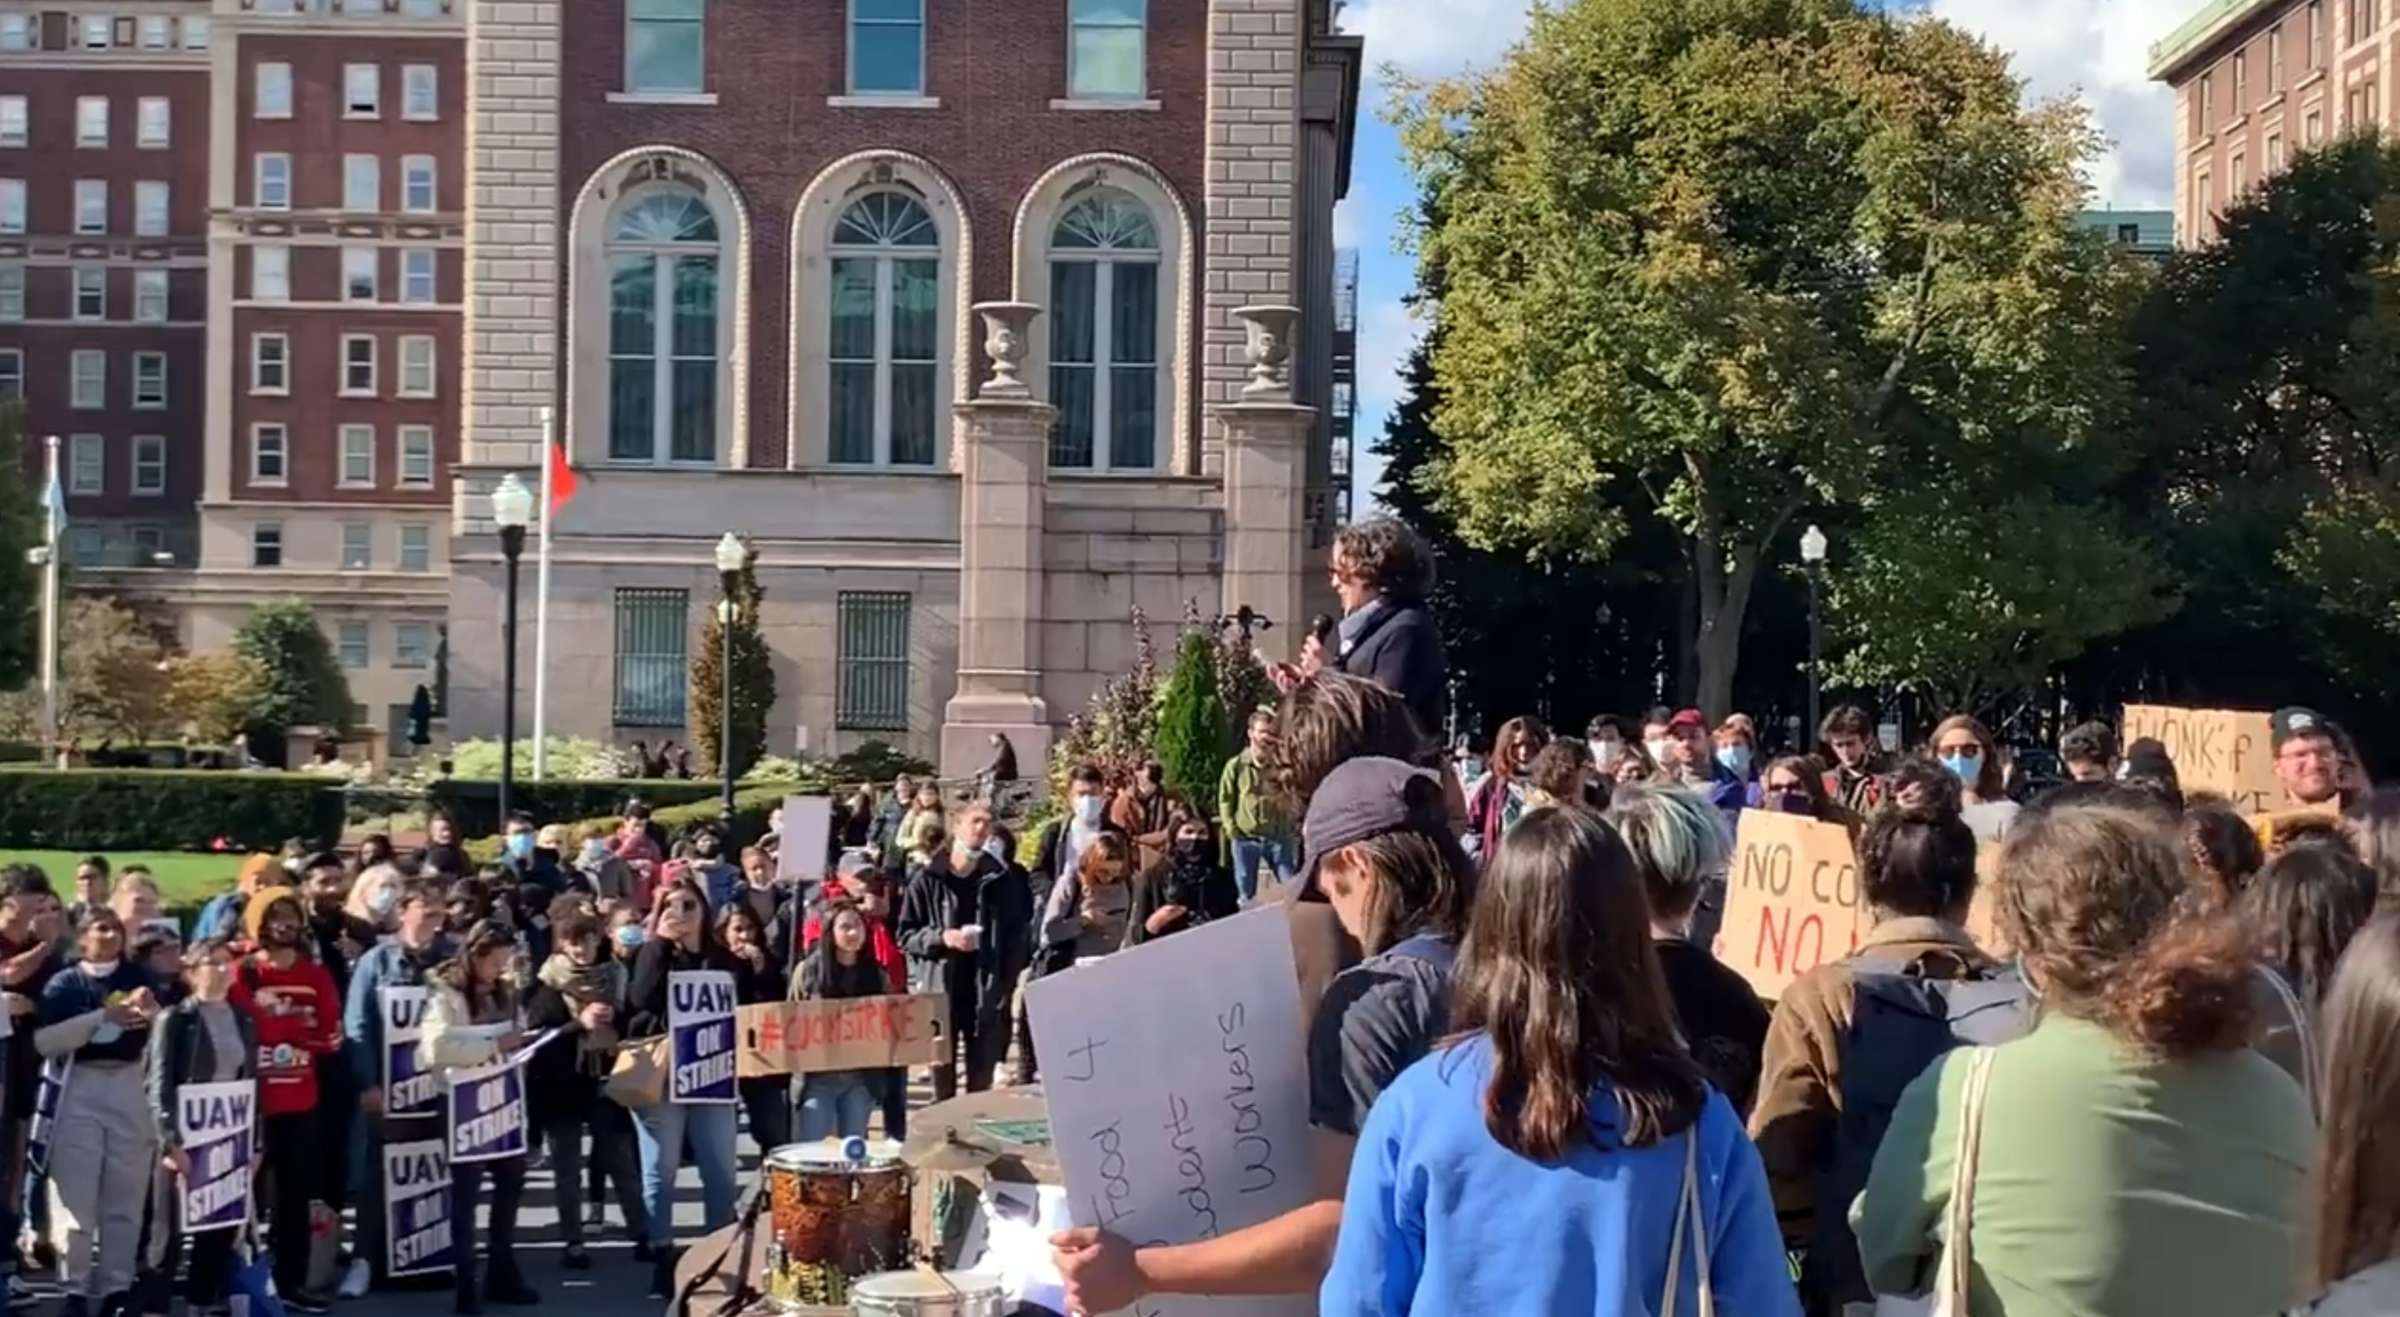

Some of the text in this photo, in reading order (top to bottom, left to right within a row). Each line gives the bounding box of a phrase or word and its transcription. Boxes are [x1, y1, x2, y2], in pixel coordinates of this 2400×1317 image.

[1743, 843, 1859, 907] NO CO
[1755, 905, 1824, 976] NO
[674, 982, 734, 1013] UAW
[696, 1024, 721, 1057] ON
[477, 1076, 506, 1112] ON
[677, 1050, 734, 1095] STRIKE
[186, 1094, 252, 1131] UAW
[456, 1099, 522, 1153] STRIKE
[1063, 1036, 1135, 1229] Food 4
[209, 1138, 235, 1178] ON
[1163, 1092, 1219, 1239] udent
